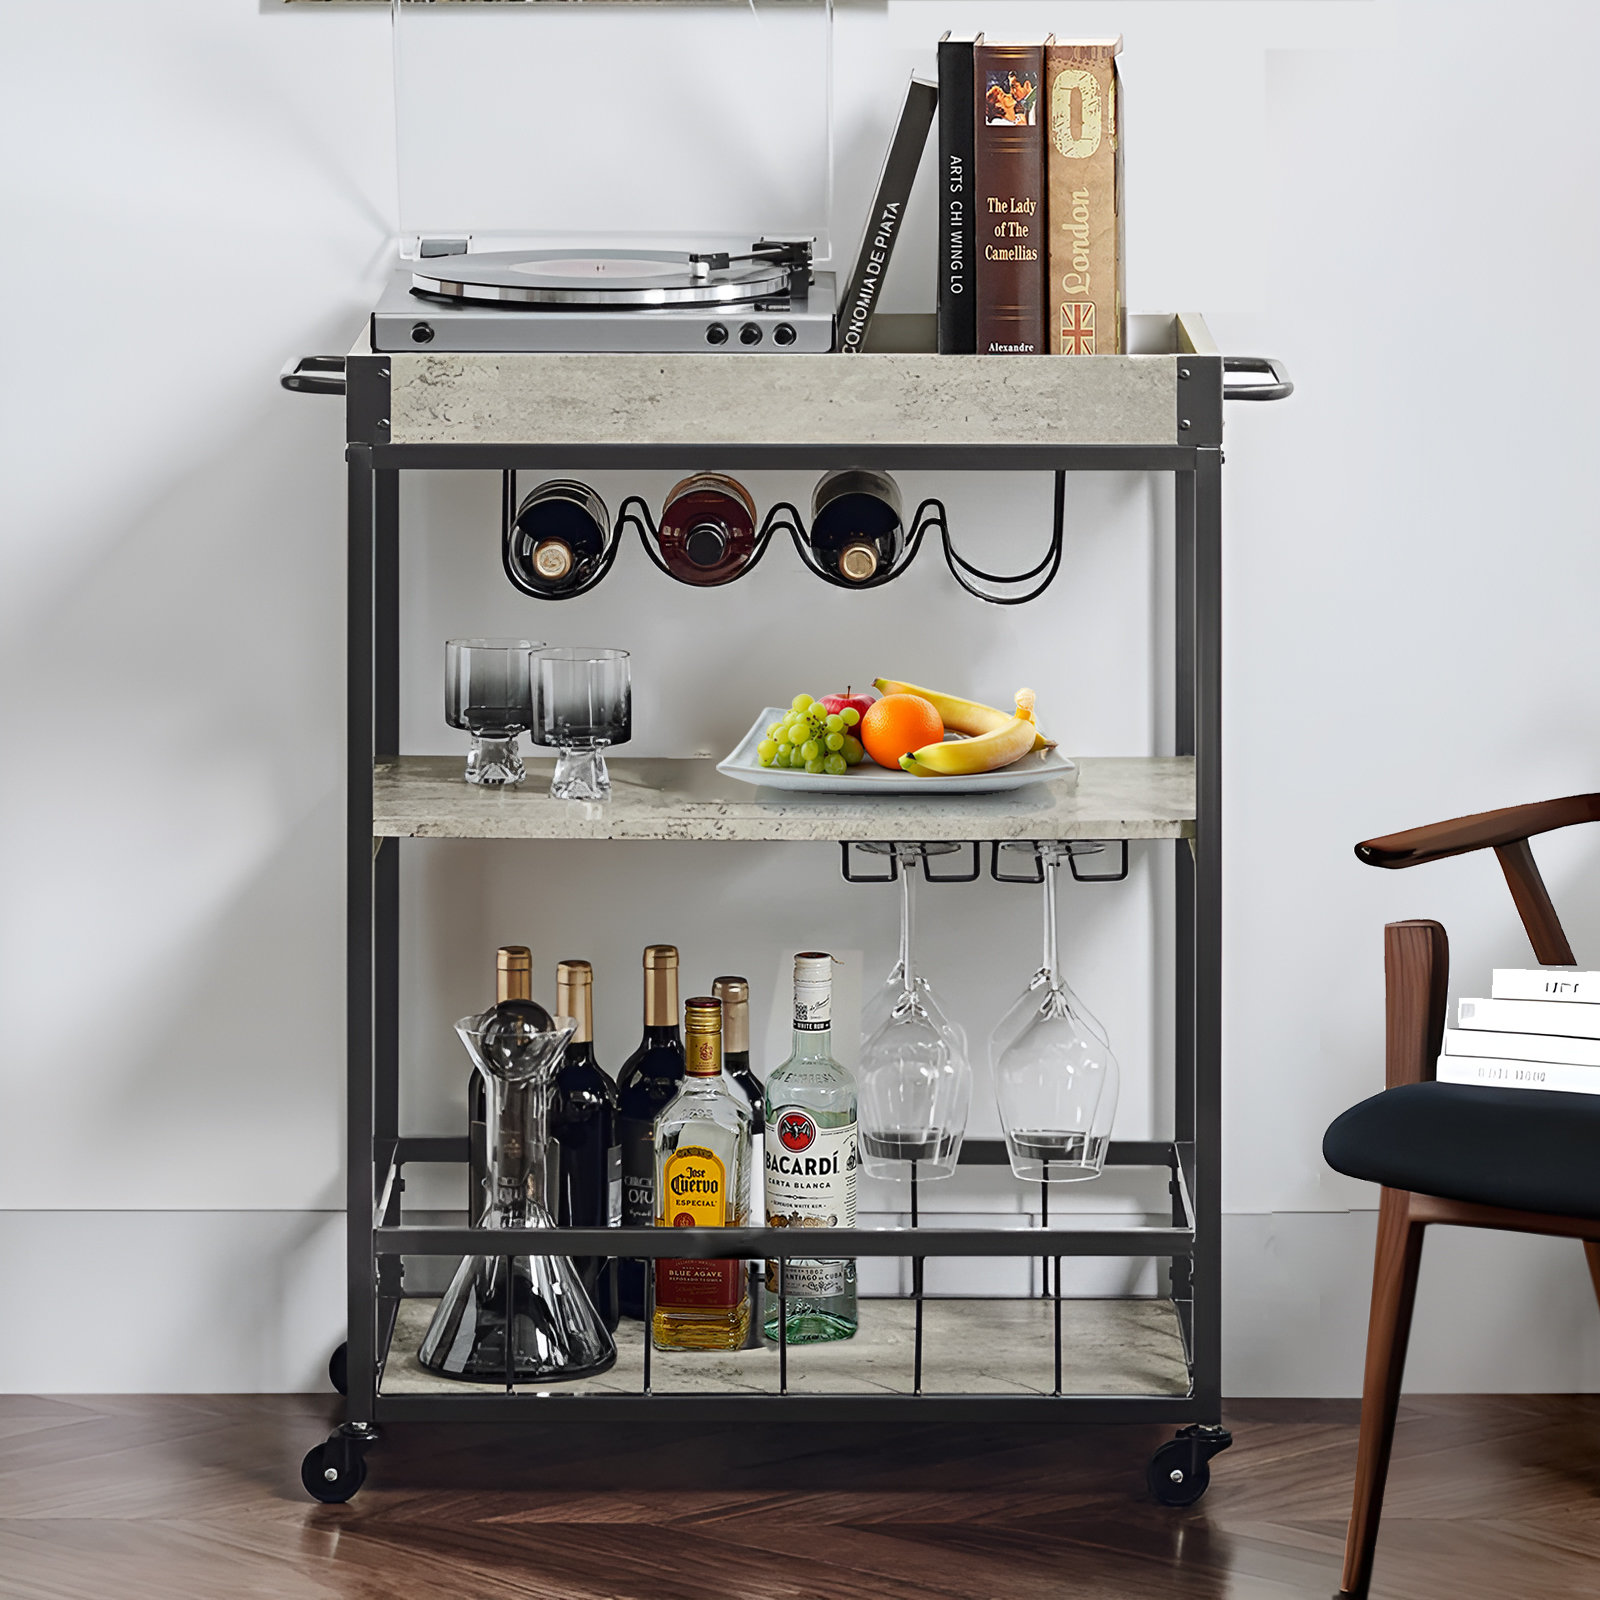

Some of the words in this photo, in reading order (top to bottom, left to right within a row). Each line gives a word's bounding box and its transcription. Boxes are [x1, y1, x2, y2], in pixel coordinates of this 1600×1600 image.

[950, 155, 963, 193] ARTS
[950, 201, 963, 226] CHI
[987, 197, 1008, 213] The
[1010, 197, 1037, 216] Lady
[874, 202, 900, 249] PIATA
[994, 222, 1006, 237] of
[1008, 222, 1029, 237] The
[950, 230, 963, 271] WING
[1062, 187, 1091, 296] London
[866, 249, 885, 275] DE
[985, 244, 1038, 261] Camellias
[950, 275, 963, 294] LO
[988, 342, 1034, 352] Alexandre
[686, 1166, 706, 1179] Jose
[766, 1150, 838, 1176] BACARDÍ
[671, 1173, 718, 1195] Cuervo
[768, 1177, 791, 1188] CARTA
[676, 1199, 715, 1207] ESPECIAL
[824, 1272, 843, 1280] CUBA
